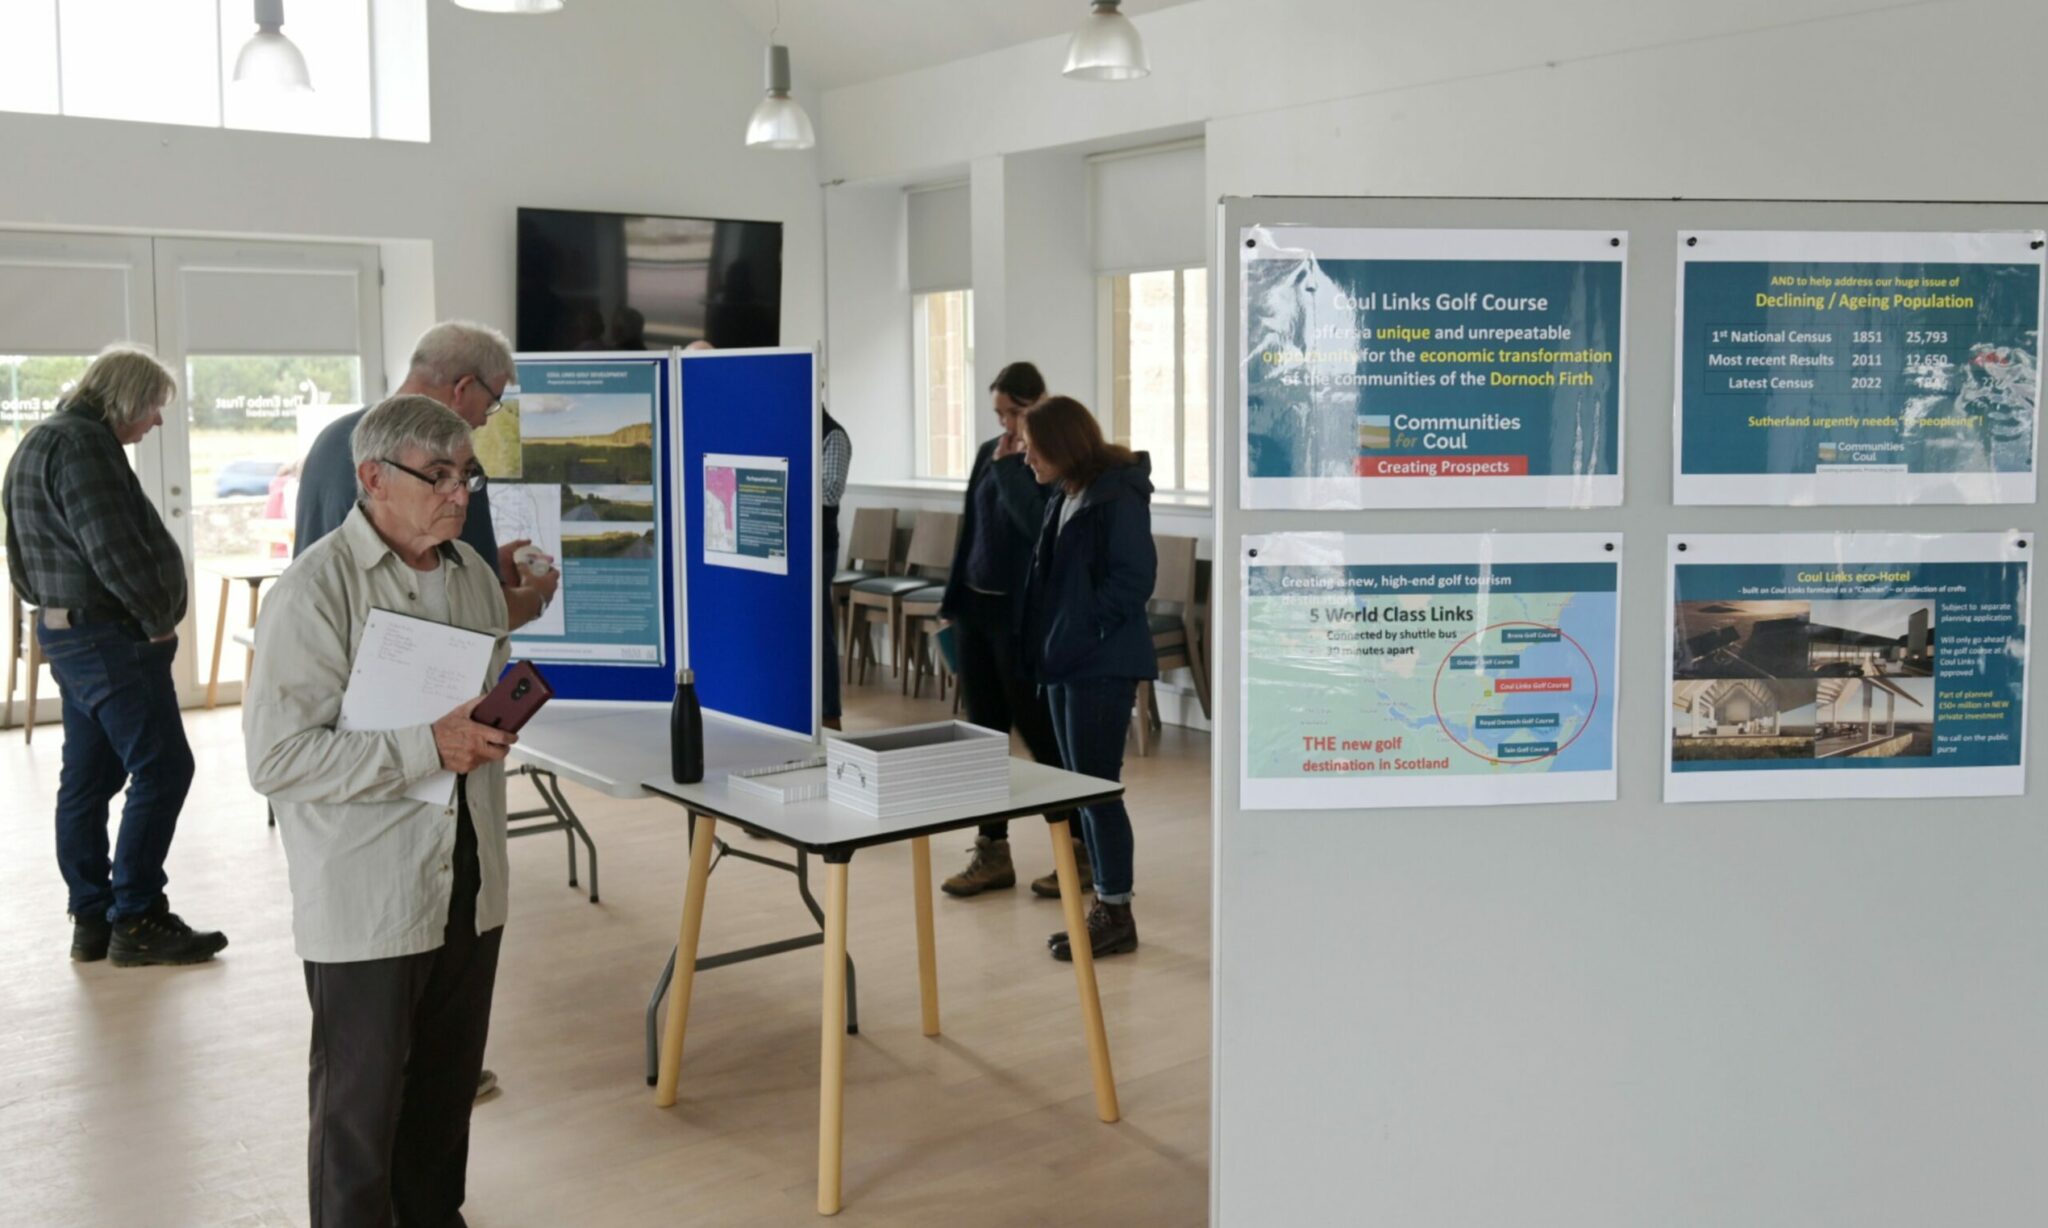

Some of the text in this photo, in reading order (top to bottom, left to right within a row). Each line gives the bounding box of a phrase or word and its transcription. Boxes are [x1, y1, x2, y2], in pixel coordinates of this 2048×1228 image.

[1771, 276, 1960, 289] AND to help address our huge issue of
[1333, 292, 1548, 311] Coul Links Golf Course
[1756, 292, 1974, 310] Declining / Ageing Population
[1314, 325, 1571, 342] offers a unique and unrepeatable
[1712, 330, 1948, 345] 1st National Census 1851 25,793
[1363, 348, 1385, 362] for
[1389, 348, 1416, 362] the
[1419, 349, 1495, 362] economic
[1499, 348, 1612, 363] transformation
[1709, 354, 1948, 367] Most recent Results 2011 12,650
[1283, 371, 1594, 386] of the communities of the Dornoch Firth
[1728, 377, 1882, 389] Latest Census 2022
[1394, 413, 1521, 430] Communities
[1748, 416, 1896, 429] Sutherland urgently needs
[1395, 433, 1468, 449] for Coul
[1838, 441, 1905, 452] Communities
[1852, 451, 1877, 461] Coul
[1377, 460, 1510, 476] Creating Prospects
[1281, 576, 1334, 589] Creating
[1348, 578, 1378, 588] new,
[1381, 575, 1435, 589] high-end
[1438, 575, 1462, 588] golf
[1465, 575, 1512, 586] tourism
[1797, 571, 1910, 582] Coul Links eco-Hotel
[1742, 586, 1759, 594] built
[1771, 586, 1786, 594] Coul
[1788, 586, 1805, 594] Links
[1905, 585, 1937, 593] collection
[1941, 603, 2011, 612] Subject to separate
[1310, 605, 1474, 623] 5 World Class Links
[1941, 614, 2012, 623] planning application
[1327, 628, 1457, 641] Connected by shuttle bus
[1956, 636, 1971, 645] only
[1972, 637, 1982, 645] go
[1342, 646, 1414, 657] minutes apart
[1941, 647, 1952, 655] the
[1953, 647, 1968, 656] golf
[1940, 669, 1974, 678] approved
[1533, 682, 1546, 690] Golf
[1964, 691, 1993, 699] planned
[1957, 701, 1982, 709] million
[1991, 700, 2010, 708] NEW
[1521, 717, 1534, 725] Golf
[1938, 712, 2004, 721] private investment
[1950, 734, 1962, 742] call
[1987, 733, 2008, 742] public
[1303, 736, 1403, 753] THE new golf
[1302, 757, 1449, 772] destination in Scotland
